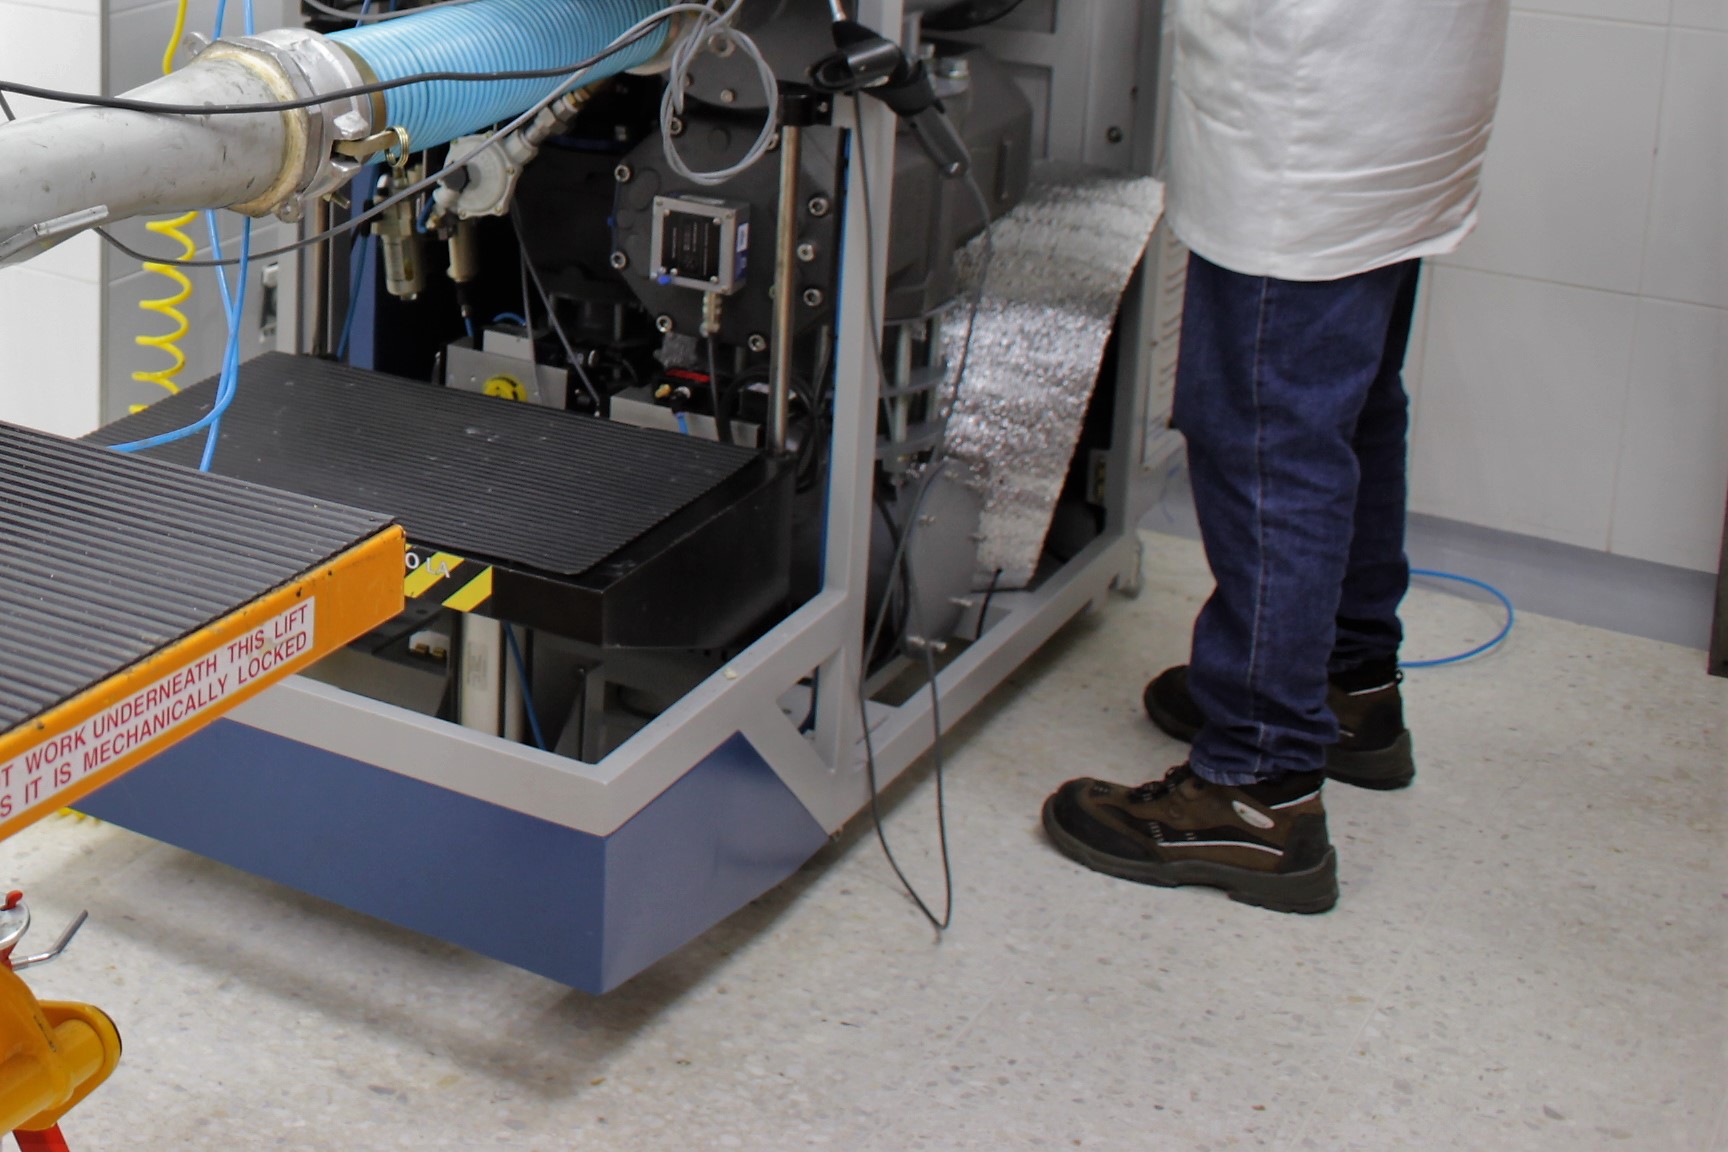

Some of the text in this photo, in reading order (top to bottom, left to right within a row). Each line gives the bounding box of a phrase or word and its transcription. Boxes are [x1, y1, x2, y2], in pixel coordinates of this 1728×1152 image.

[24, 776, 43, 804] IT
[54, 762, 72, 788] IS
[83, 673, 228, 772] MECHANICALLY
[238, 631, 307, 685] LOCKED
[25, 727, 86, 775] WORK
[92, 654, 217, 739] UNDERNEATH
[227, 629, 265, 663] THIS
[274, 604, 308, 639] LIFT
